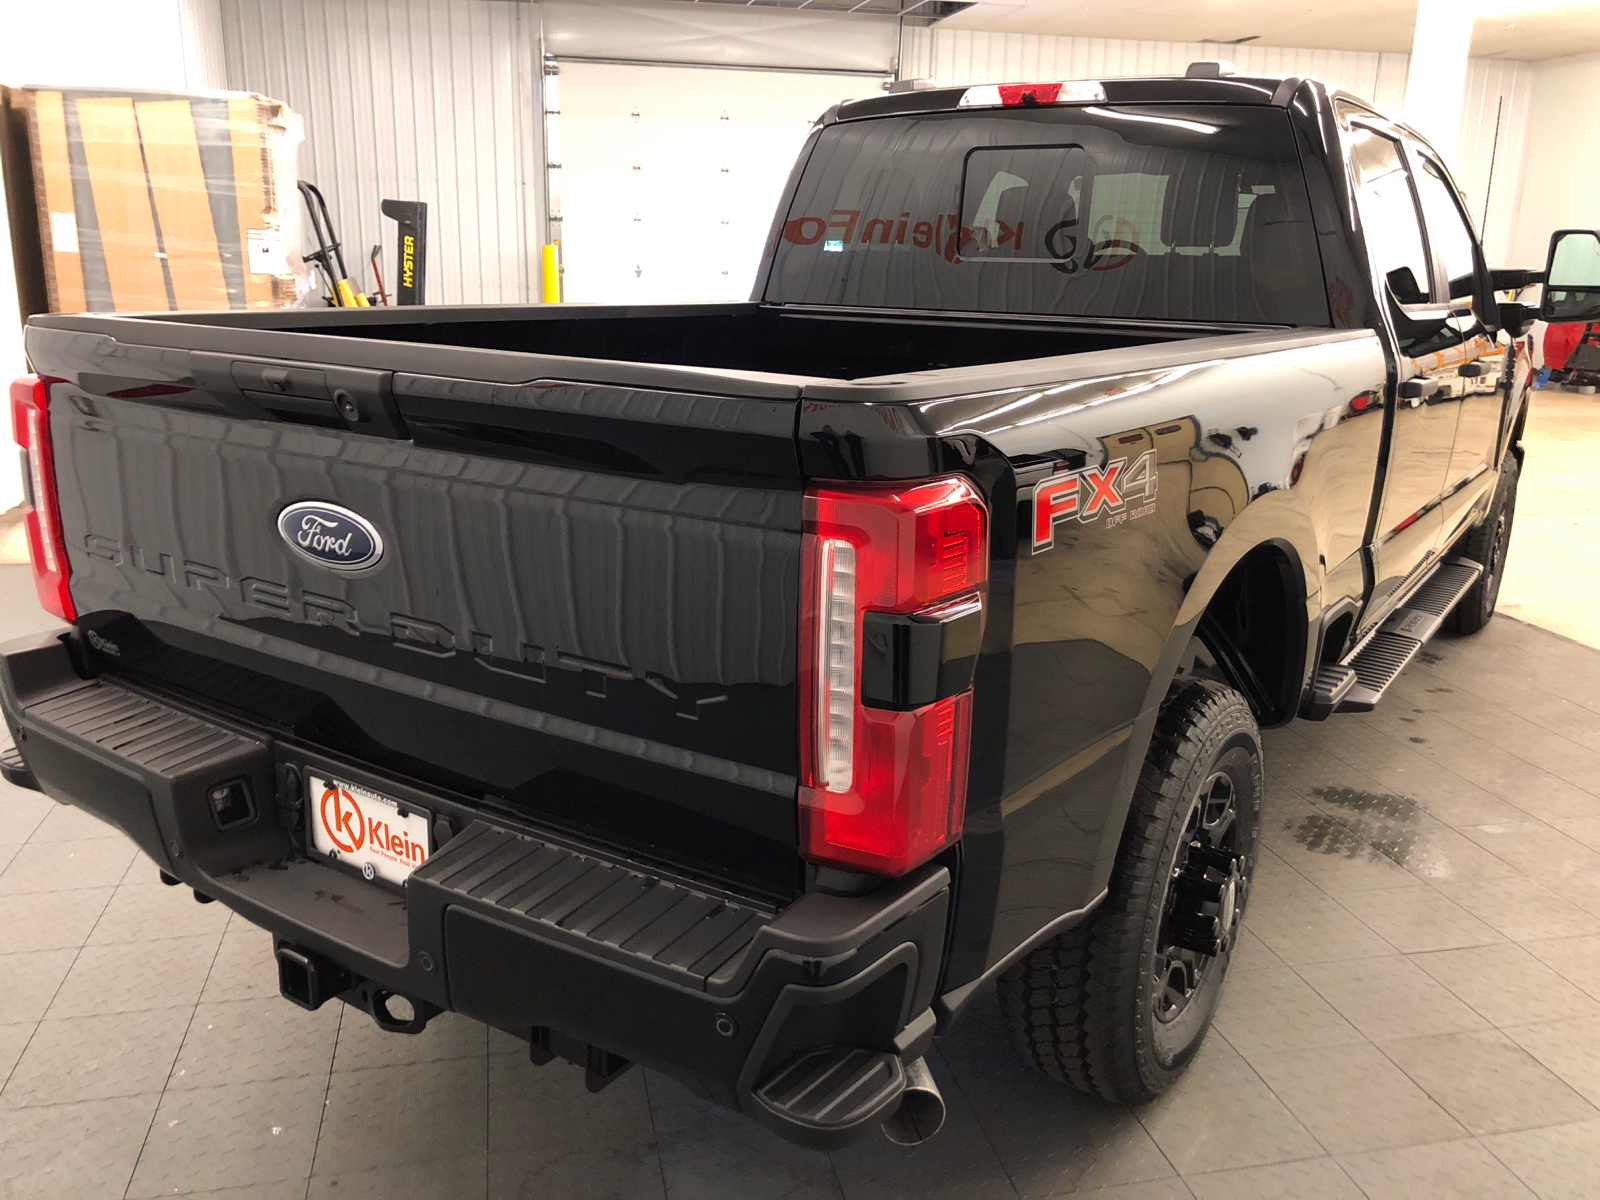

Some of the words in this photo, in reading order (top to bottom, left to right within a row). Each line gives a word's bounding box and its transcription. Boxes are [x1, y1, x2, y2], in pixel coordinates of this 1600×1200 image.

[402, 235, 414, 288] HYSTER
[1031, 448, 1158, 556] FX4
[1106, 513, 1127, 529] OFF
[1129, 502, 1156, 521] ROAD
[297, 514, 352, 557] Ford
[84, 533, 361, 636] SUPER
[390, 611, 728, 721] DUTY
[332, 778, 398, 808] www.kleinauto.com
[368, 817, 425, 866] Klein
[369, 846, 380, 855] Real
